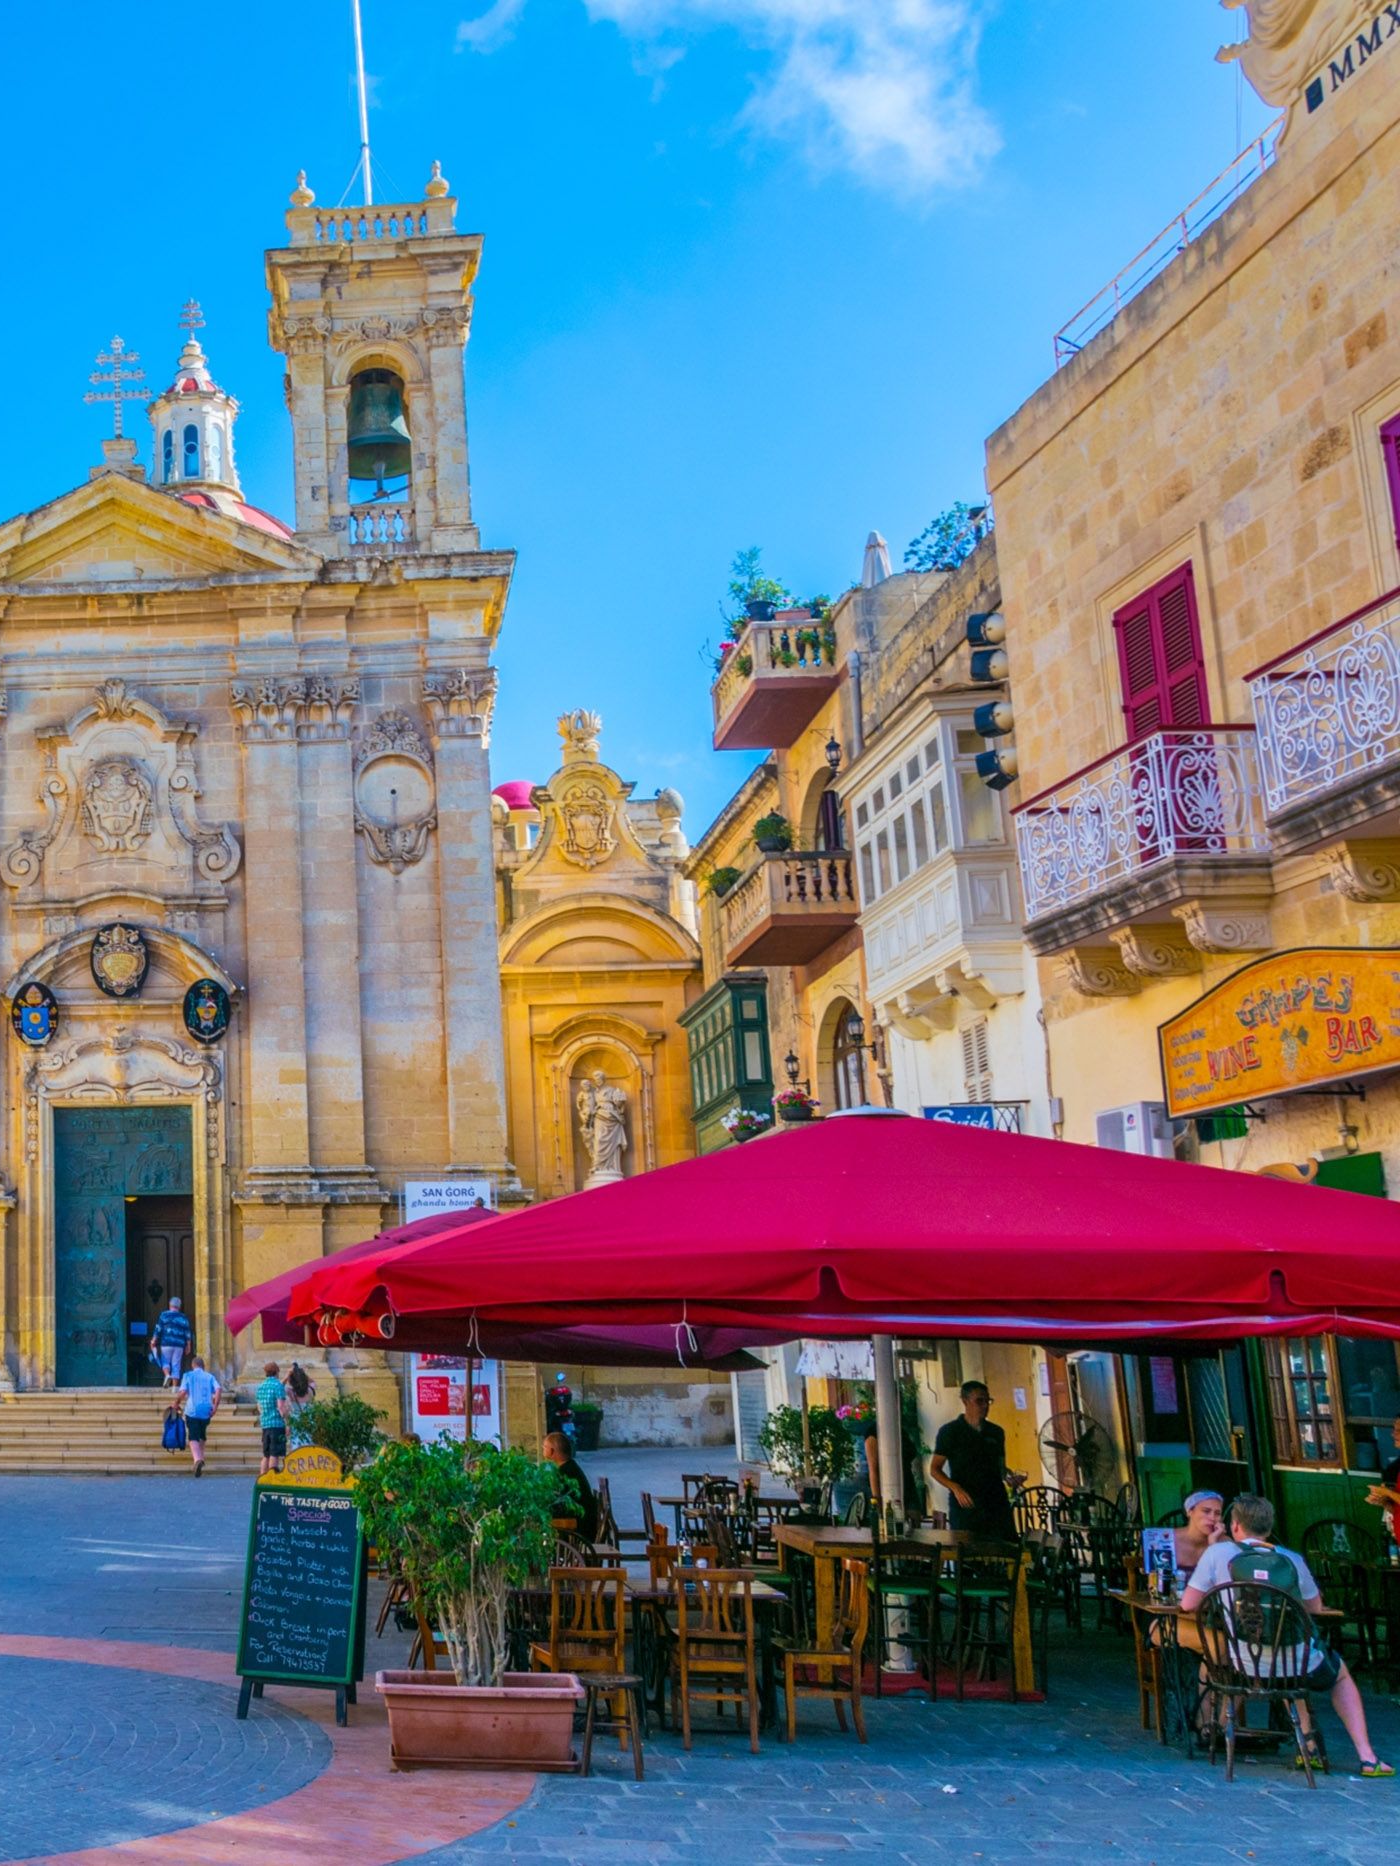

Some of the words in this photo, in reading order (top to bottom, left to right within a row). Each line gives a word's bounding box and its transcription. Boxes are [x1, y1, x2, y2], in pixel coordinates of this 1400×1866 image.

[1235, 971, 1355, 1031] GRAPES
[1207, 1034, 1262, 1081] WINE
[1323, 1016, 1383, 1062] BAR
[422, 1188, 443, 1198] SAN
[450, 1376, 457, 1384] 4
[287, 1455, 338, 1475] GRAPES
[280, 1496, 294, 1506] THE
[296, 1498, 319, 1508] TASTE
[327, 1500, 350, 1510] GOZO
[287, 1507, 332, 1521] Specials
[261, 1520, 285, 1534] Fresh
[331, 1528, 342, 1537] in
[287, 1572, 304, 1582] and
[252, 1611, 276, 1627] Duck
[316, 1625, 326, 1633] in
[266, 1631, 285, 1640] and
[249, 1637, 265, 1650] For
[268, 1640, 329, 1662] Reservations
